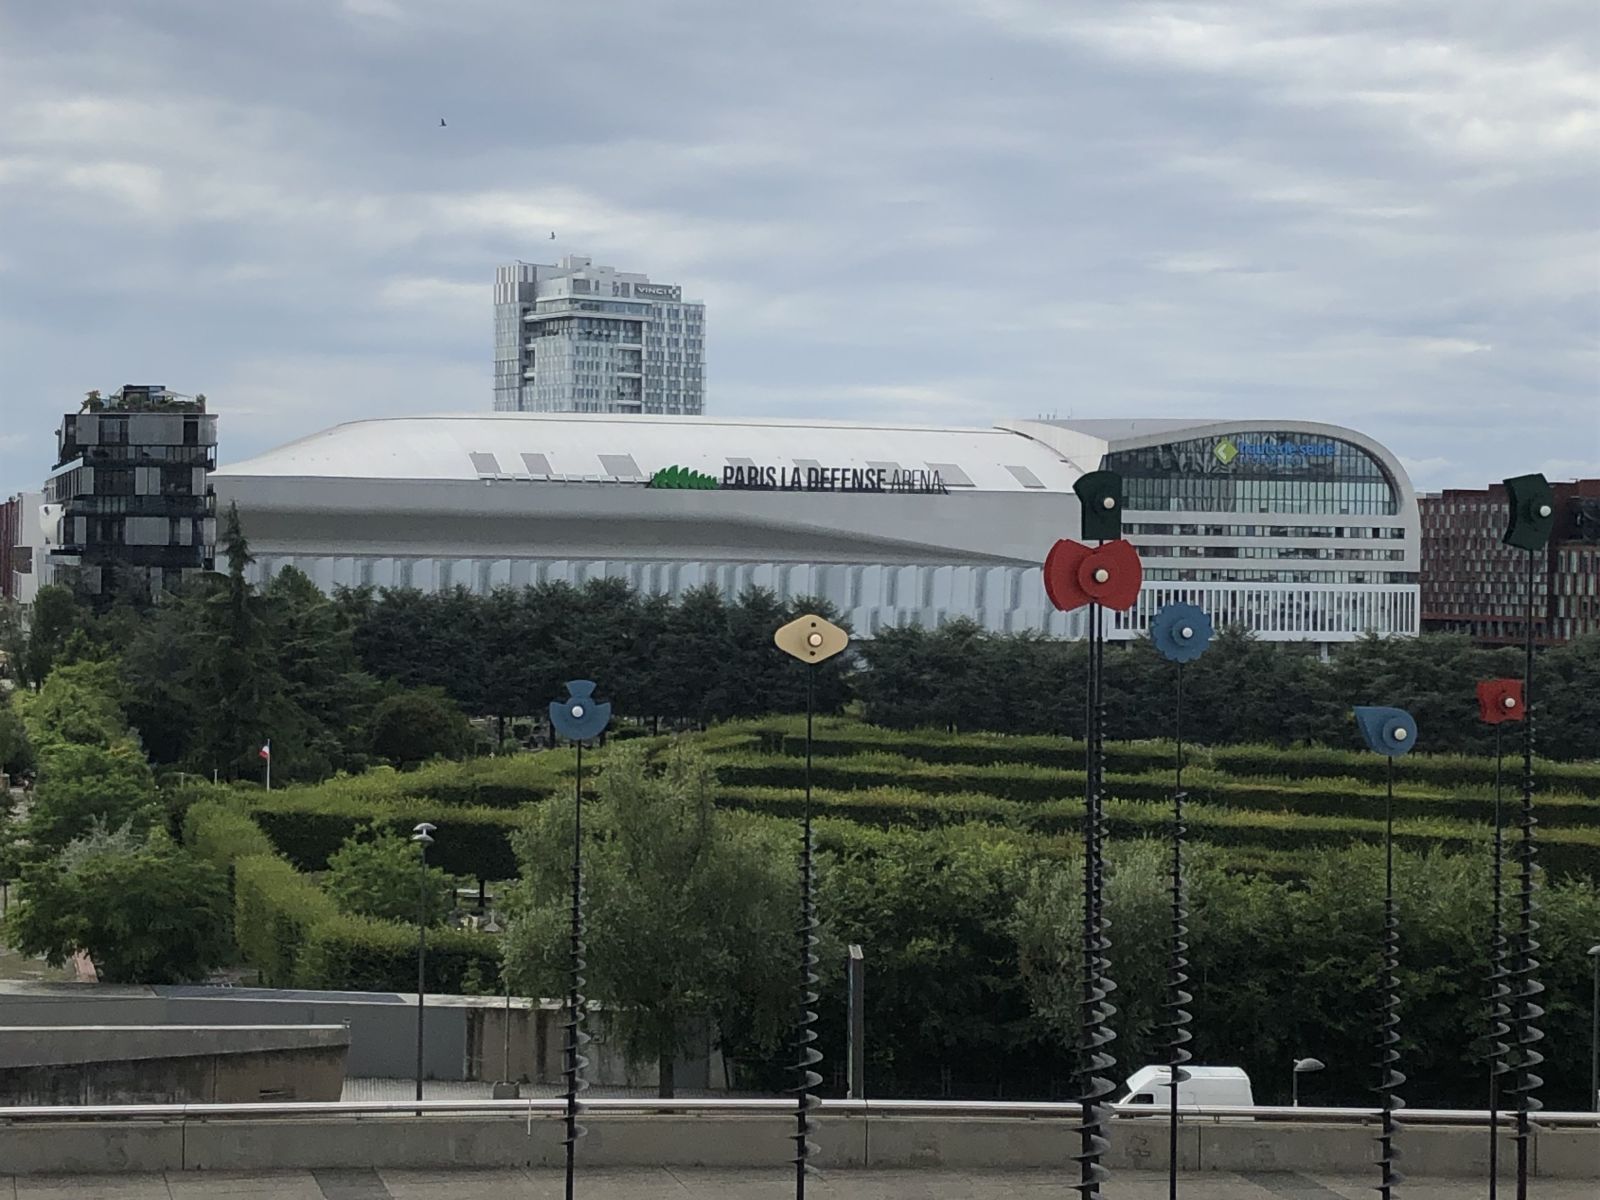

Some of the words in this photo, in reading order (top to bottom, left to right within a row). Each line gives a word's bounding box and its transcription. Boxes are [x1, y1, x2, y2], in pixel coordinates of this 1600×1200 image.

[638, 287, 667, 295] VINCI
[723, 466, 776, 489] PARIS
[781, 466, 802, 490] LA
[807, 467, 886, 491] DEFENSE
[892, 469, 944, 493] ARENA
